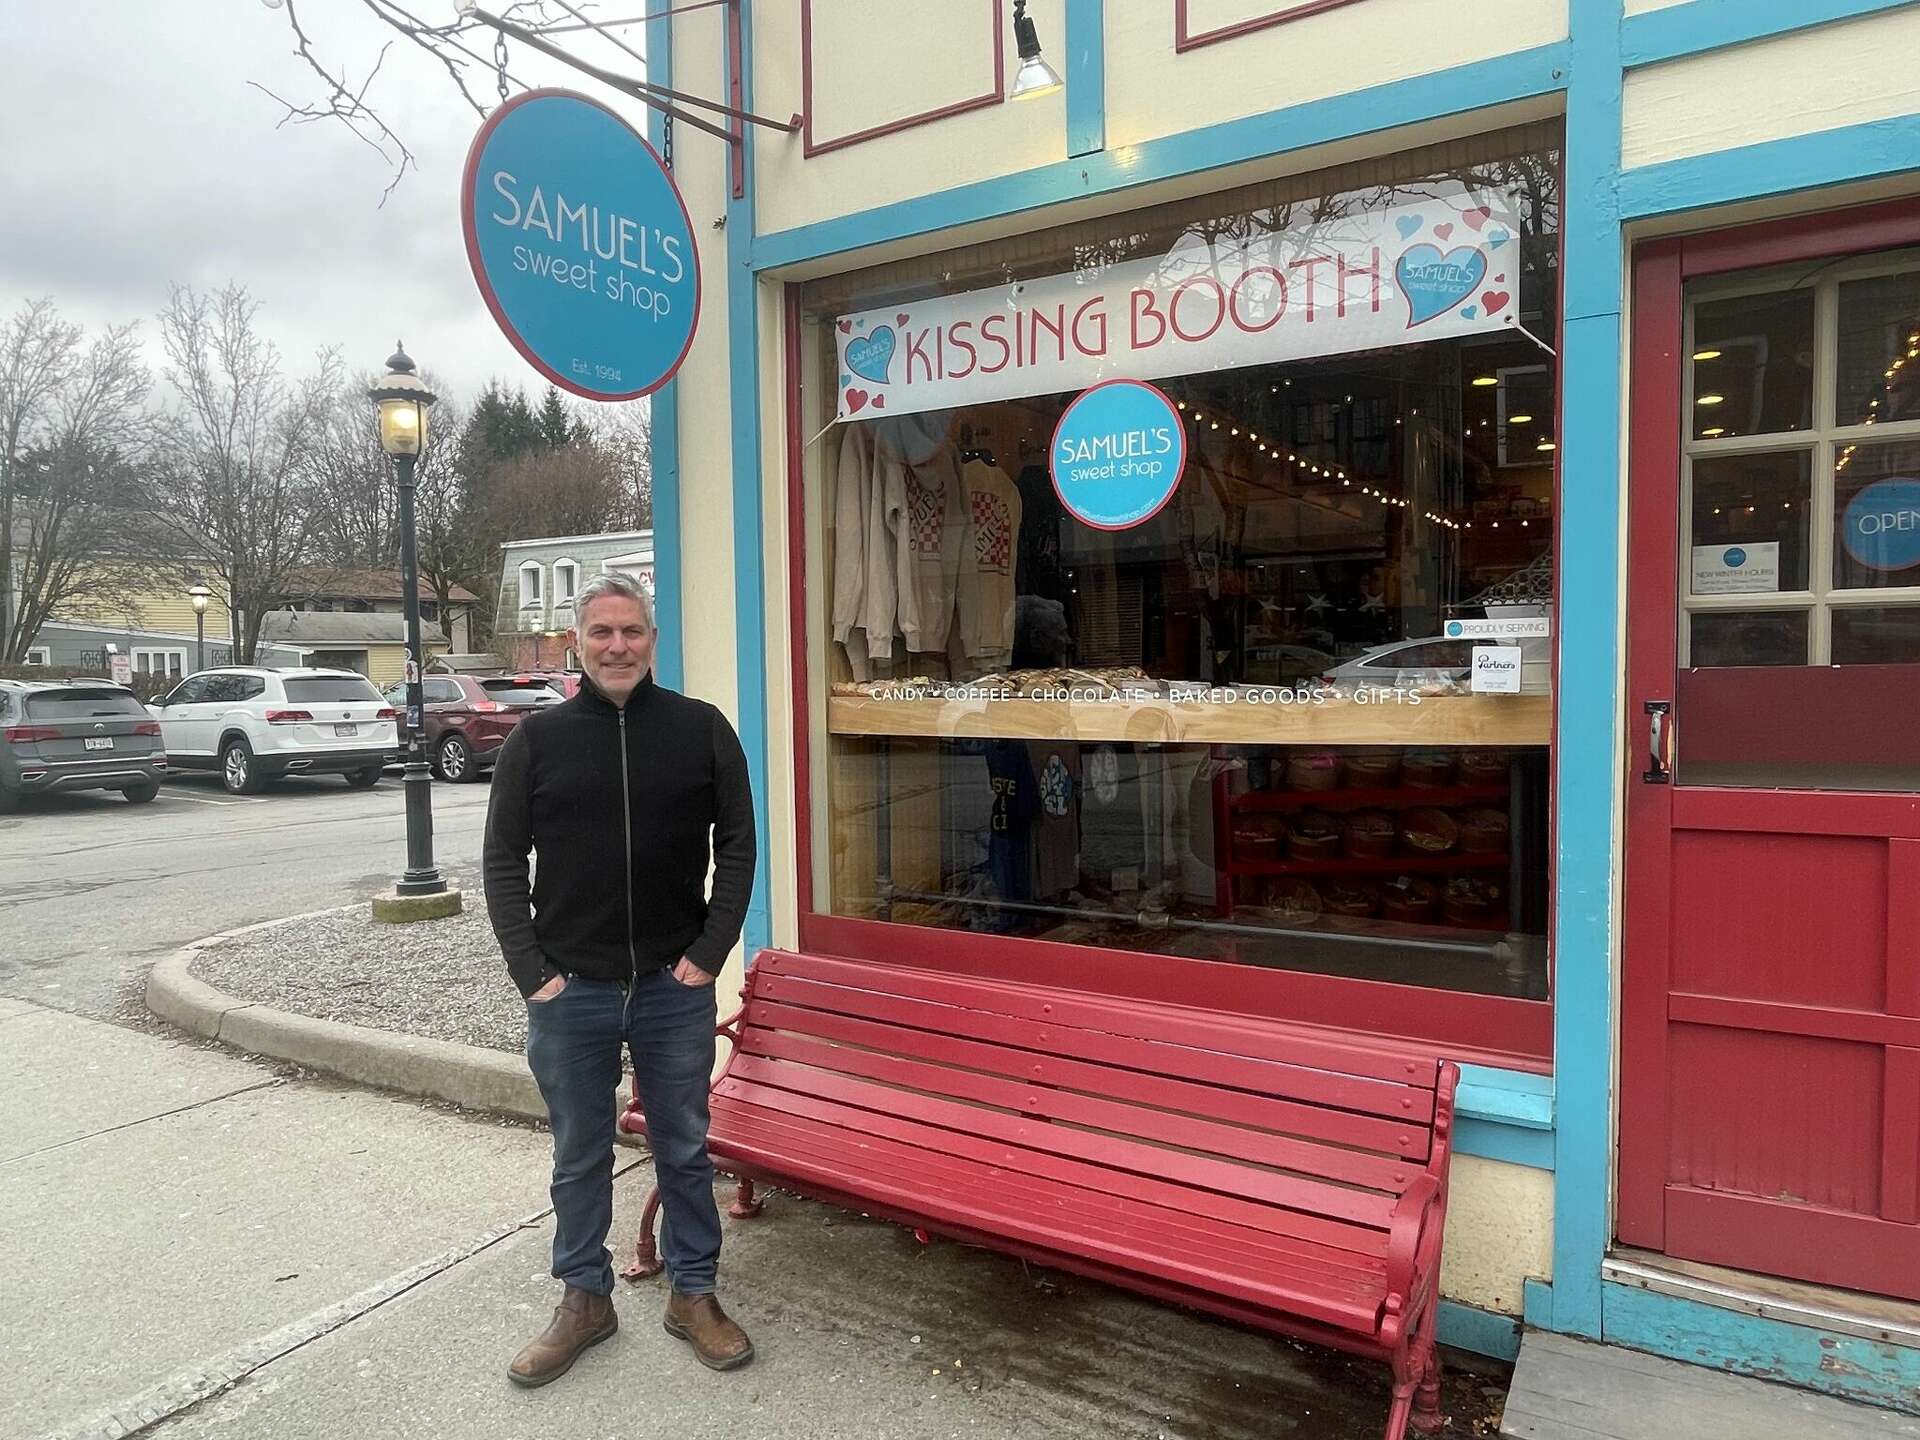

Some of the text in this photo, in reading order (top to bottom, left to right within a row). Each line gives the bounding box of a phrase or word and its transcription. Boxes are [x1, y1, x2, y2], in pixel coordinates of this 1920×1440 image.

[492, 171, 683, 283] SAMUEL'S
[513, 245, 671, 322] sweet shop
[905, 246, 1380, 385] KISSING BOOTH
[1061, 428, 1171, 464] SAMUEL'S
[1071, 458, 1162, 481] sweet shop
[1464, 623, 1504, 634] PROUDLY
[1506, 622, 1545, 633] SERVING
[1478, 654, 1516, 669] Partners
[872, 687, 1422, 705] CANDY COFFEE CHOCOLATE BAKED GOODS GIFTS
